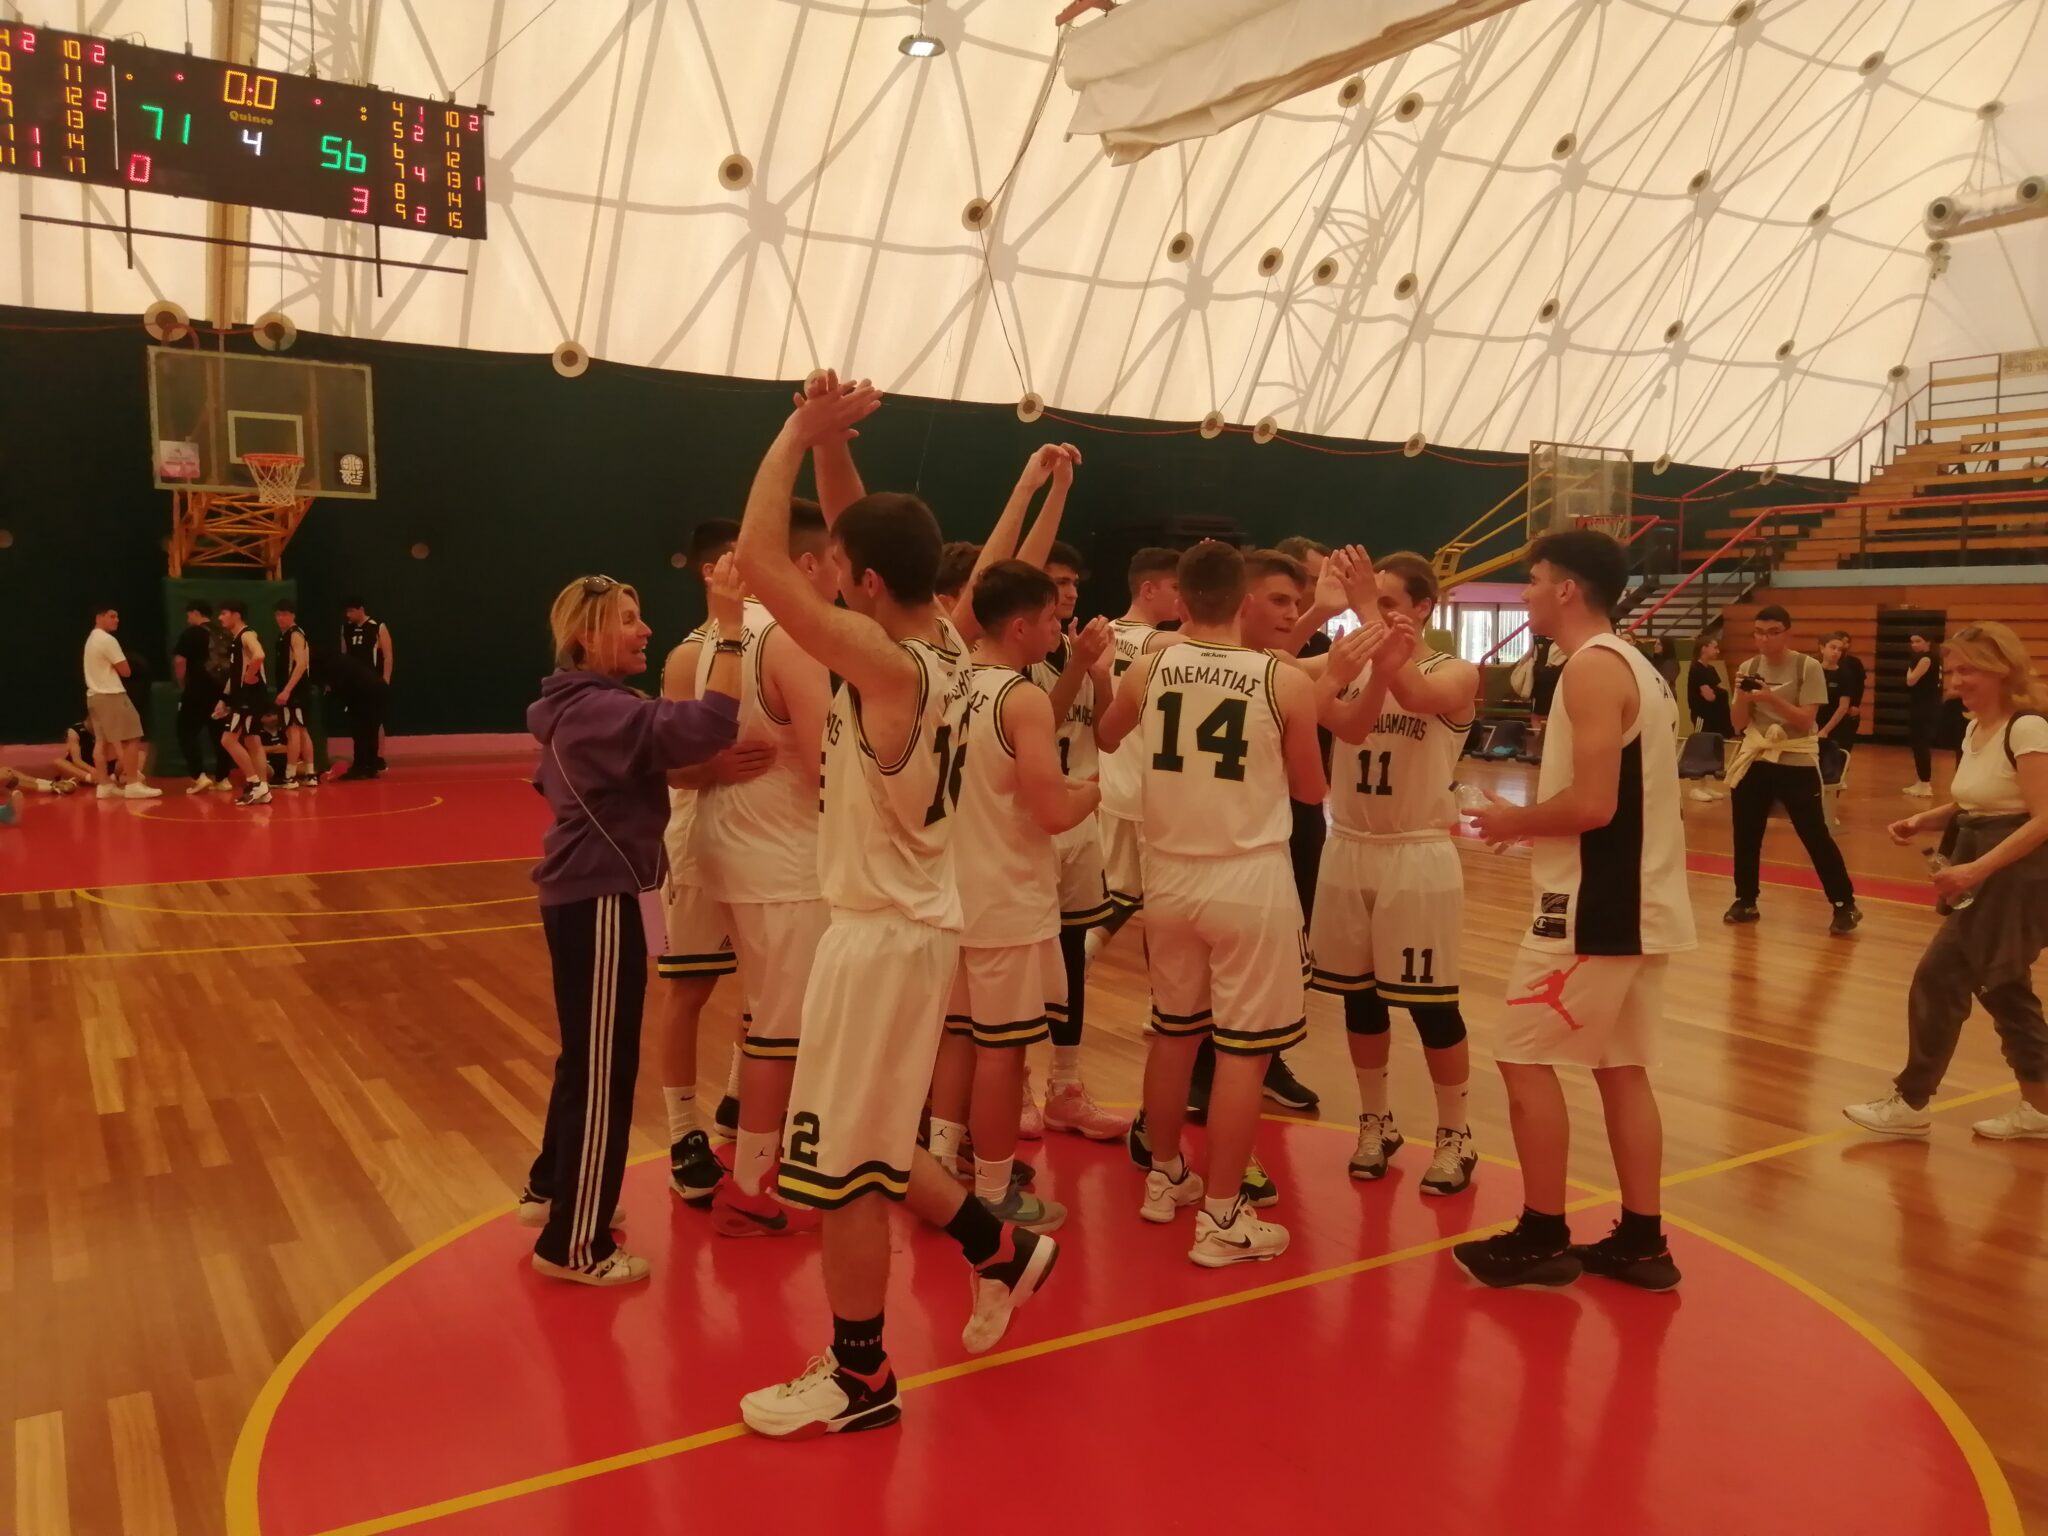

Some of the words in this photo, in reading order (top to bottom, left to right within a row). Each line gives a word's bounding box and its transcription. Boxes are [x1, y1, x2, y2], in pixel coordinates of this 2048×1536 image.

[23, 31, 35, 51] 2
[63, 40, 81, 60] 10
[93, 44, 105, 64] 2
[64, 63, 81, 82] 11
[66, 86, 82, 106] 12
[95, 90, 107, 110] 2
[67, 110, 84, 129] 13
[229, 110, 274, 126] Quince
[392, 101, 403, 118] 4
[140, 104, 191, 145] 71
[393, 121, 404, 139] 5
[414, 124, 424, 142] 2
[446, 111, 460, 128] 10
[468, 115, 479, 132] 2
[34, 127, 41, 144] 1
[68, 133, 85, 151] 14
[242, 129, 263, 156] 4
[446, 131, 460, 148] 11
[37, 150, 42, 168] 1
[321, 135, 367, 173] 56
[393, 142, 405, 159] 6
[446, 151, 461, 168] 12
[130, 153, 151, 183] 0
[394, 162, 405, 179] 7
[414, 166, 426, 183] 4
[395, 182, 406, 200] 8
[447, 171, 462, 188] 13
[476, 176, 482, 191] 1
[352, 187, 369, 214] 3
[448, 191, 462, 208] 14
[395, 203, 407, 220] 9
[416, 206, 427, 223] 2
[448, 212, 463, 229] 15
[1161, 665, 1262, 698] ΠΛΕΜΑΤΙΑΣ
[1152, 691, 1249, 782] 14
[1371, 713, 1428, 742] ALAMATAS
[1356, 749, 1393, 796] 11
[1400, 947, 1434, 983] 11
